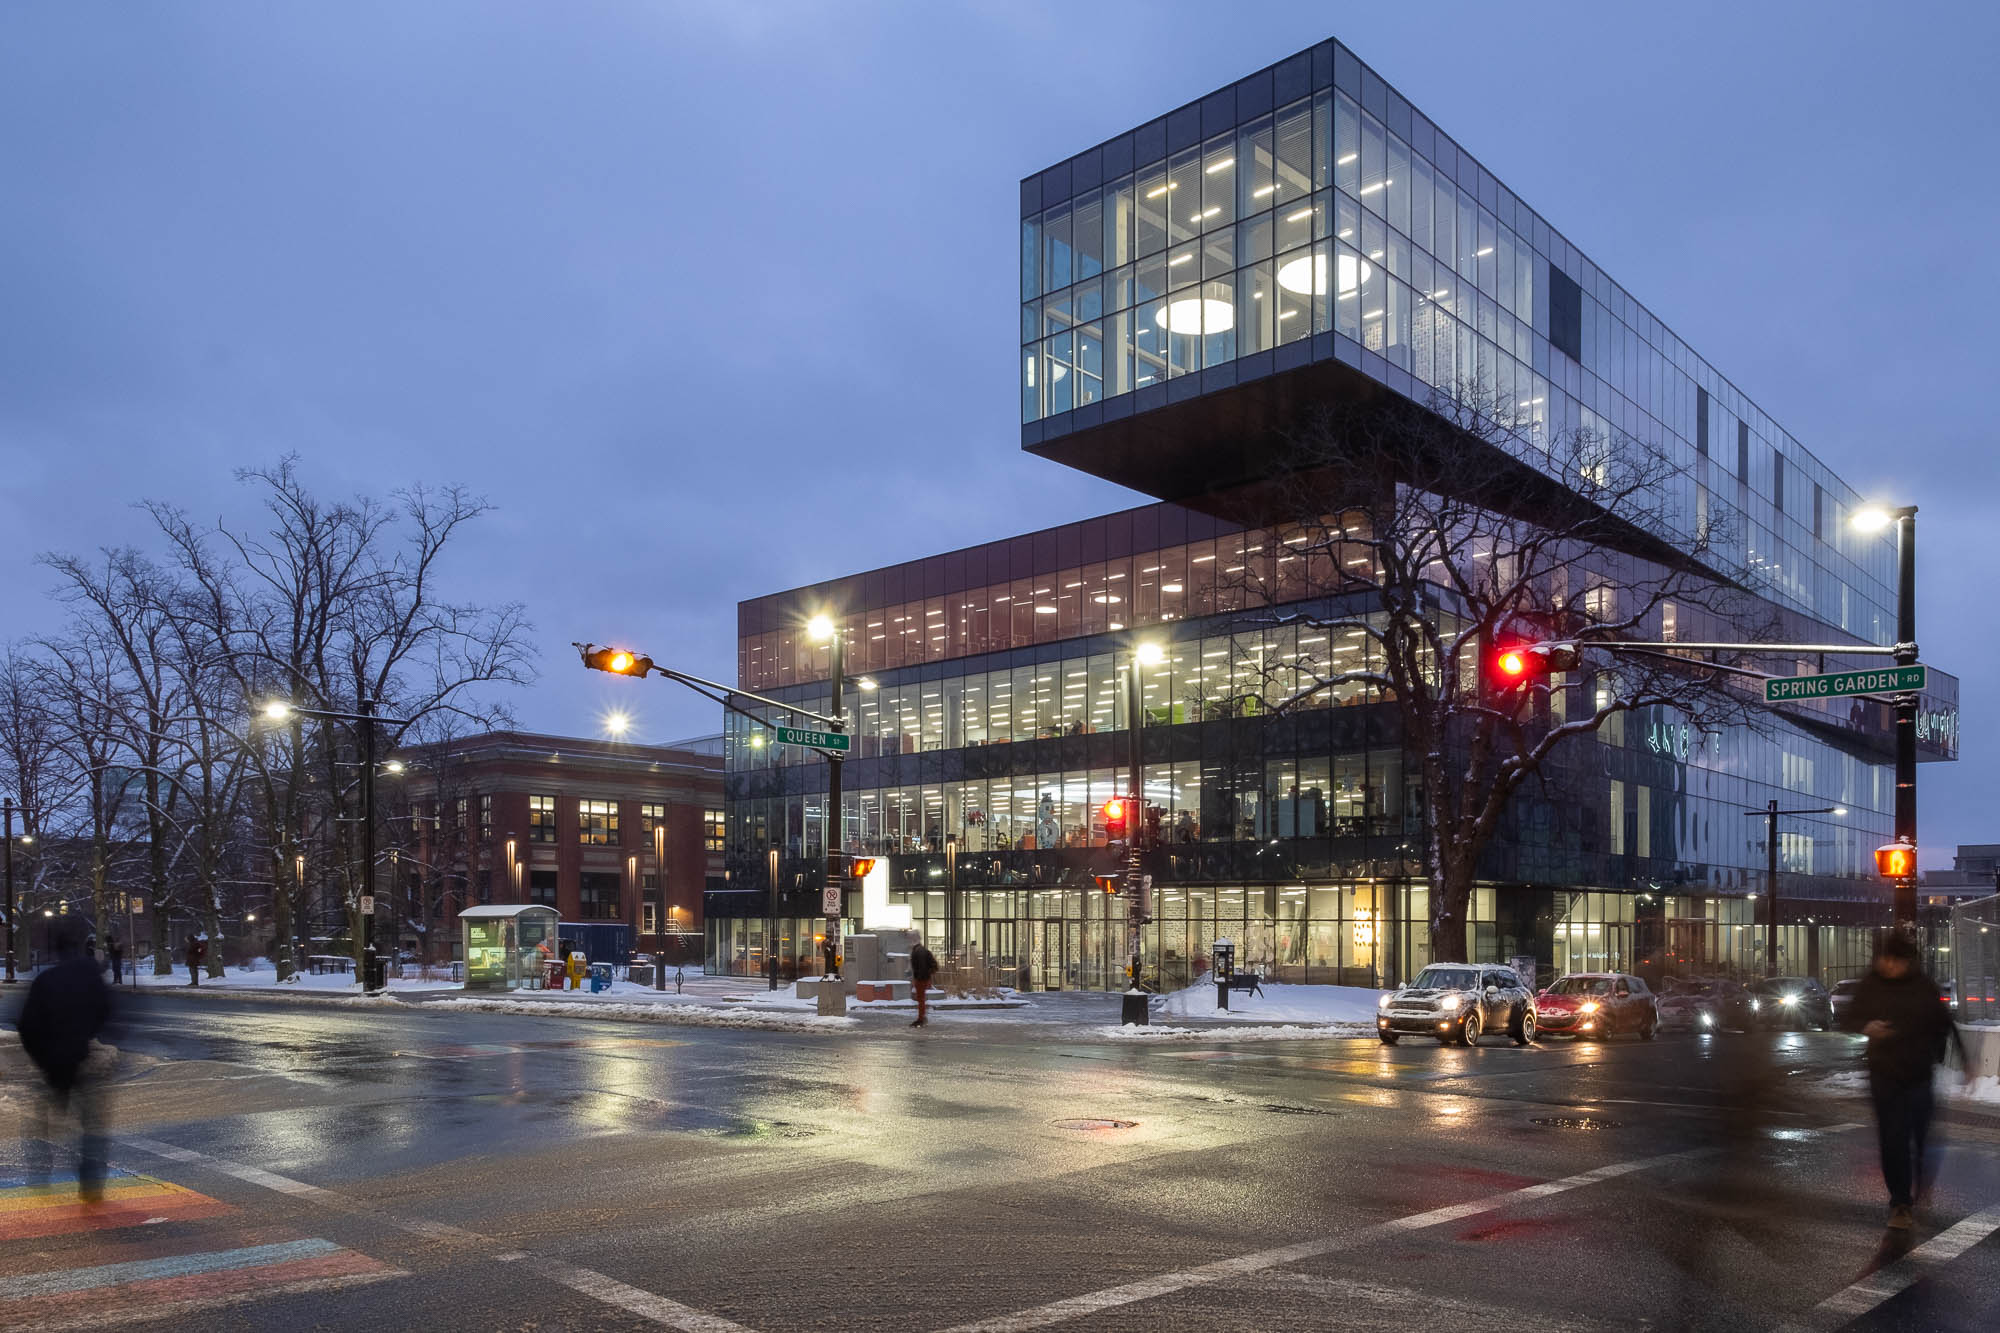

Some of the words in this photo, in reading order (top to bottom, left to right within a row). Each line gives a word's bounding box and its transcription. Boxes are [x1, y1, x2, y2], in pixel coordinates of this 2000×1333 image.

[1771, 679, 1828, 697] SPRING
[1834, 673, 1898, 692] GARDEN
[1907, 674, 1920, 683] RD
[787, 730, 826, 745] QUEEN
